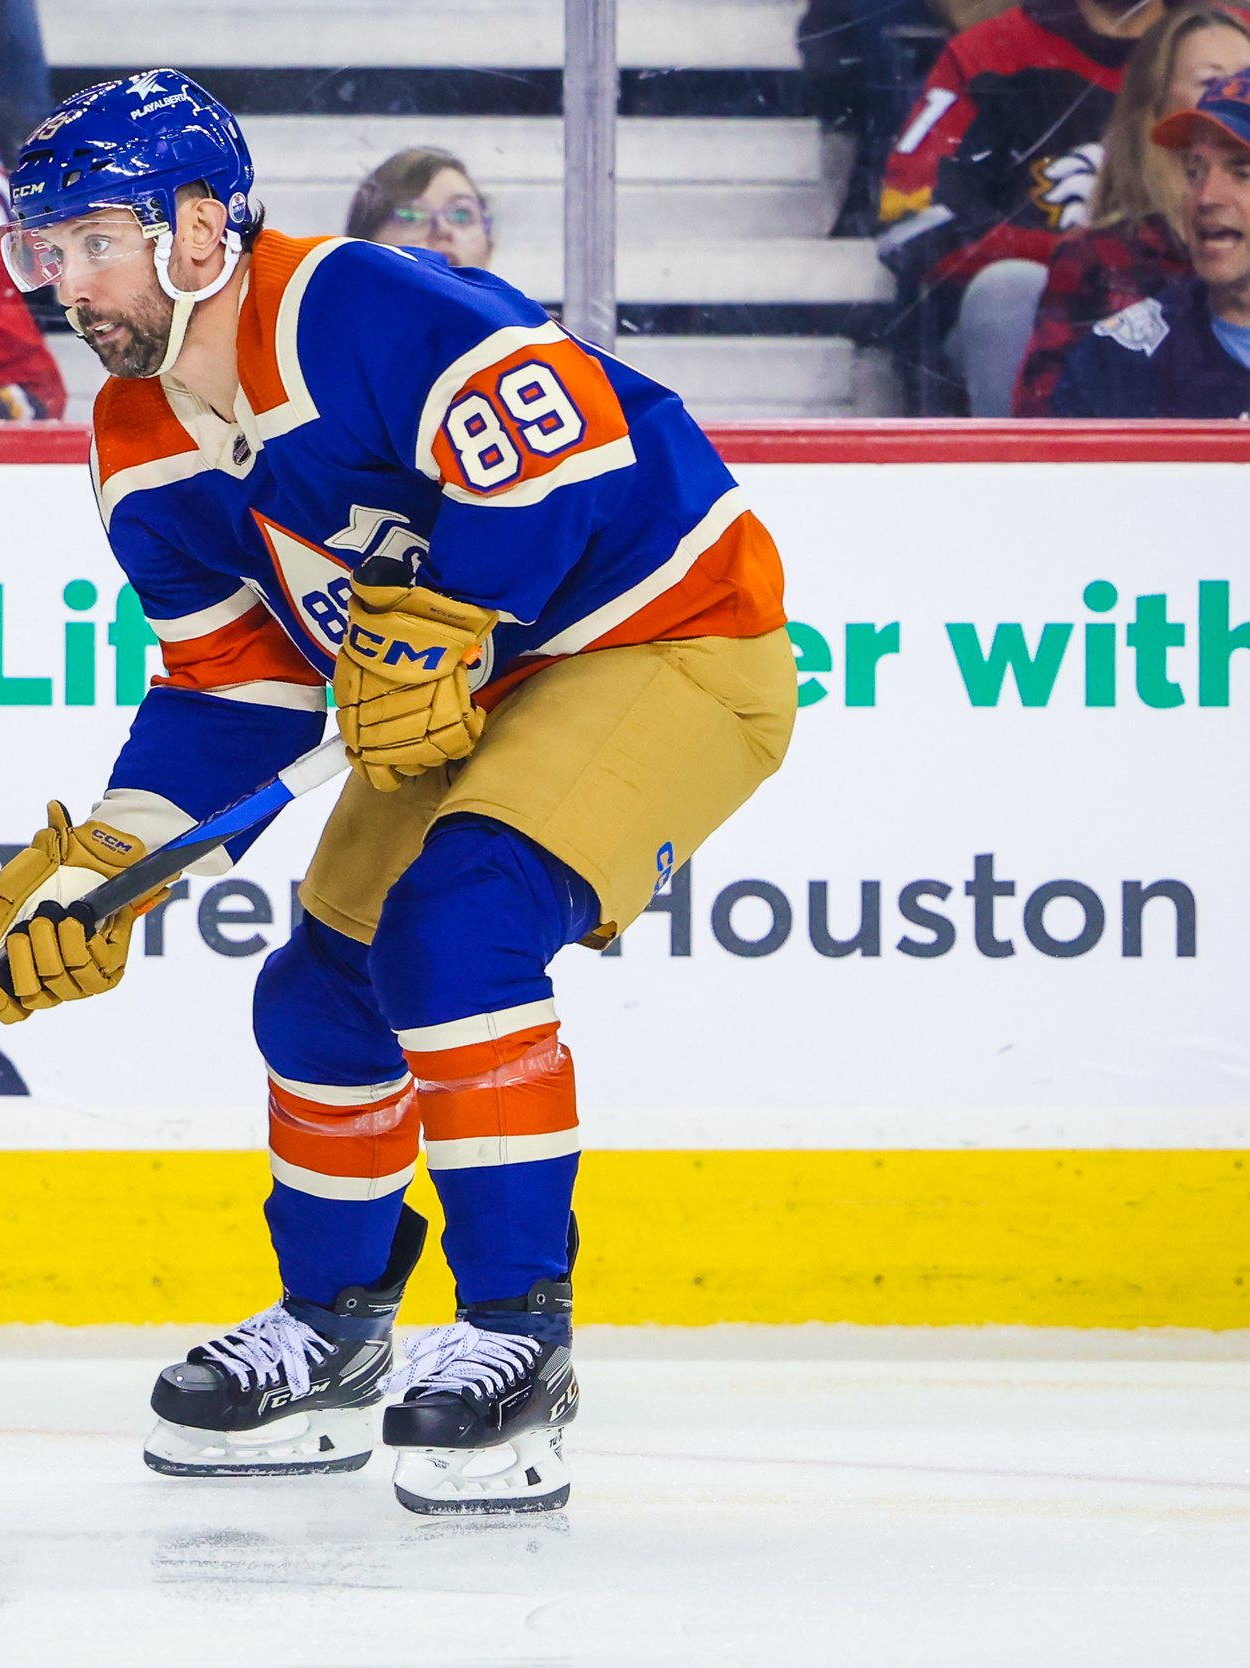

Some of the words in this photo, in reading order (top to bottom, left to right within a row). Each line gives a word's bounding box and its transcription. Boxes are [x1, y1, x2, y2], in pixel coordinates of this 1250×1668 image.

[896, 88, 957, 154] 1
[13, 182, 46, 199] CCM
[444, 359, 588, 492] 89
[345, 622, 448, 671] CM
[945, 580, 1250, 708] with
[92, 829, 133, 852] CCM
[600, 853, 1196, 958] Houston
